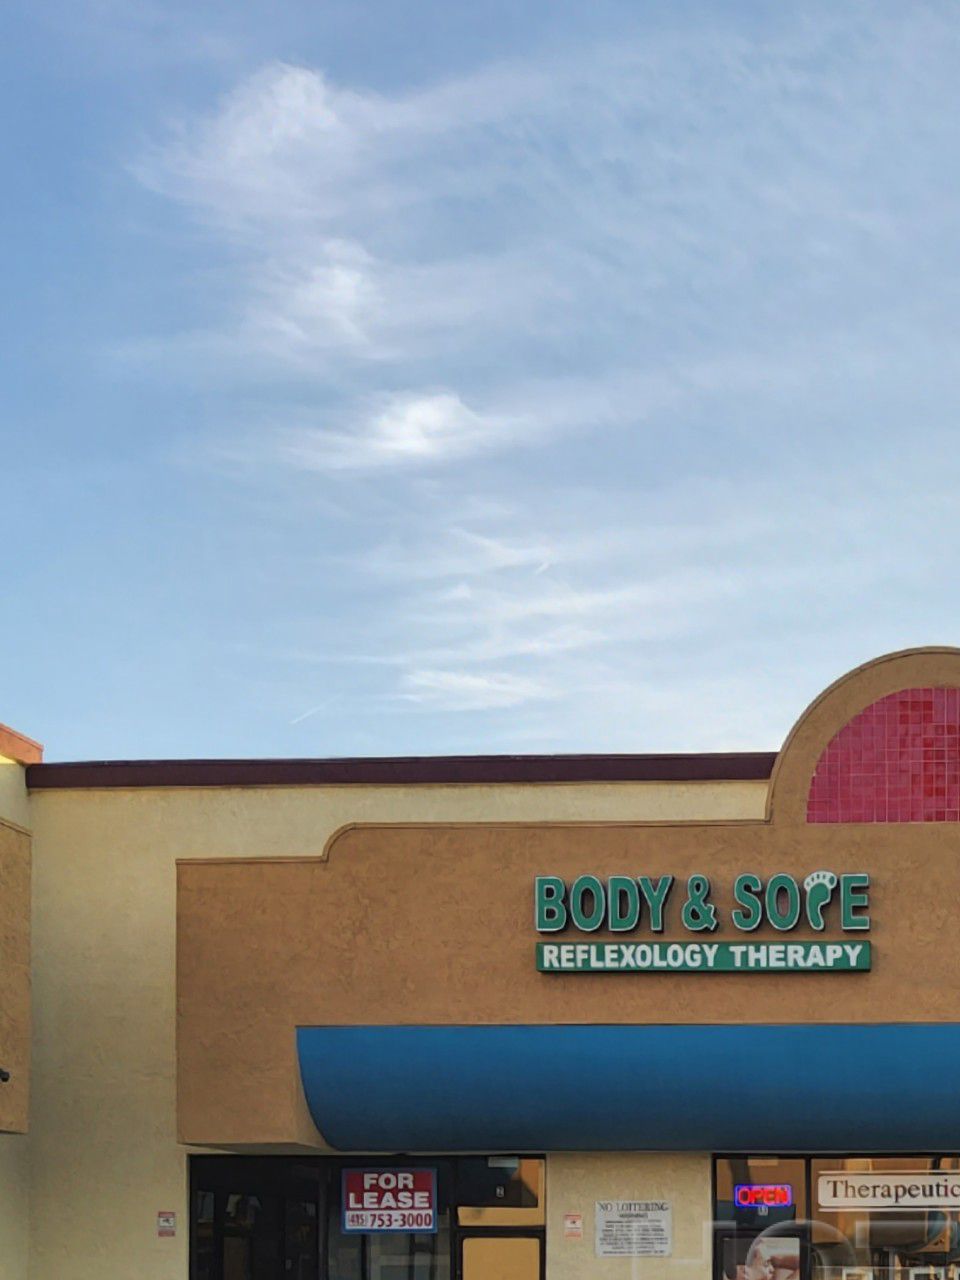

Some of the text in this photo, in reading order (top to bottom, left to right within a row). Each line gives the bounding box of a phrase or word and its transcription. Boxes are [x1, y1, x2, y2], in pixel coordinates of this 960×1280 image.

[535, 873, 673, 932] BODY
[681, 874, 719, 932] &
[543, 944, 863, 968] REFLEXOLOGY THERAPY
[363, 1173, 414, 1190] FOR
[349, 1191, 430, 1209] LEASE
[738, 1186, 789, 1205] OPEN
[598, 1202, 669, 1212] NO LOITERING
[370, 1213, 432, 1228] 753-3000
